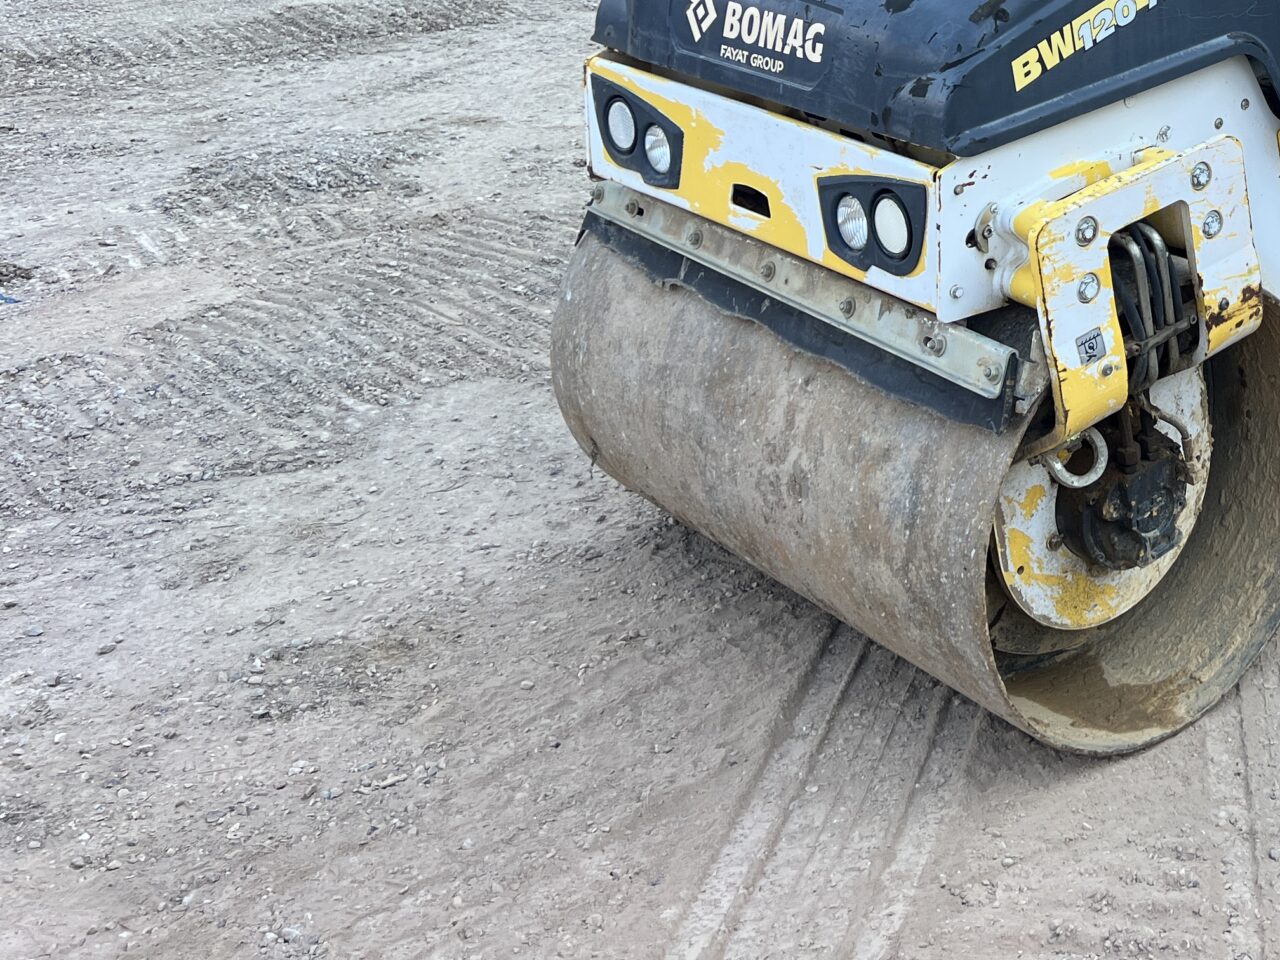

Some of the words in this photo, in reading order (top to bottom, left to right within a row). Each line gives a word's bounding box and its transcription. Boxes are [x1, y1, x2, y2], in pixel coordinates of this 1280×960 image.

[723, 1, 826, 63] BOMAG
[720, 44, 749, 64] FAYAT
[750, 53, 784, 74] GROUP
